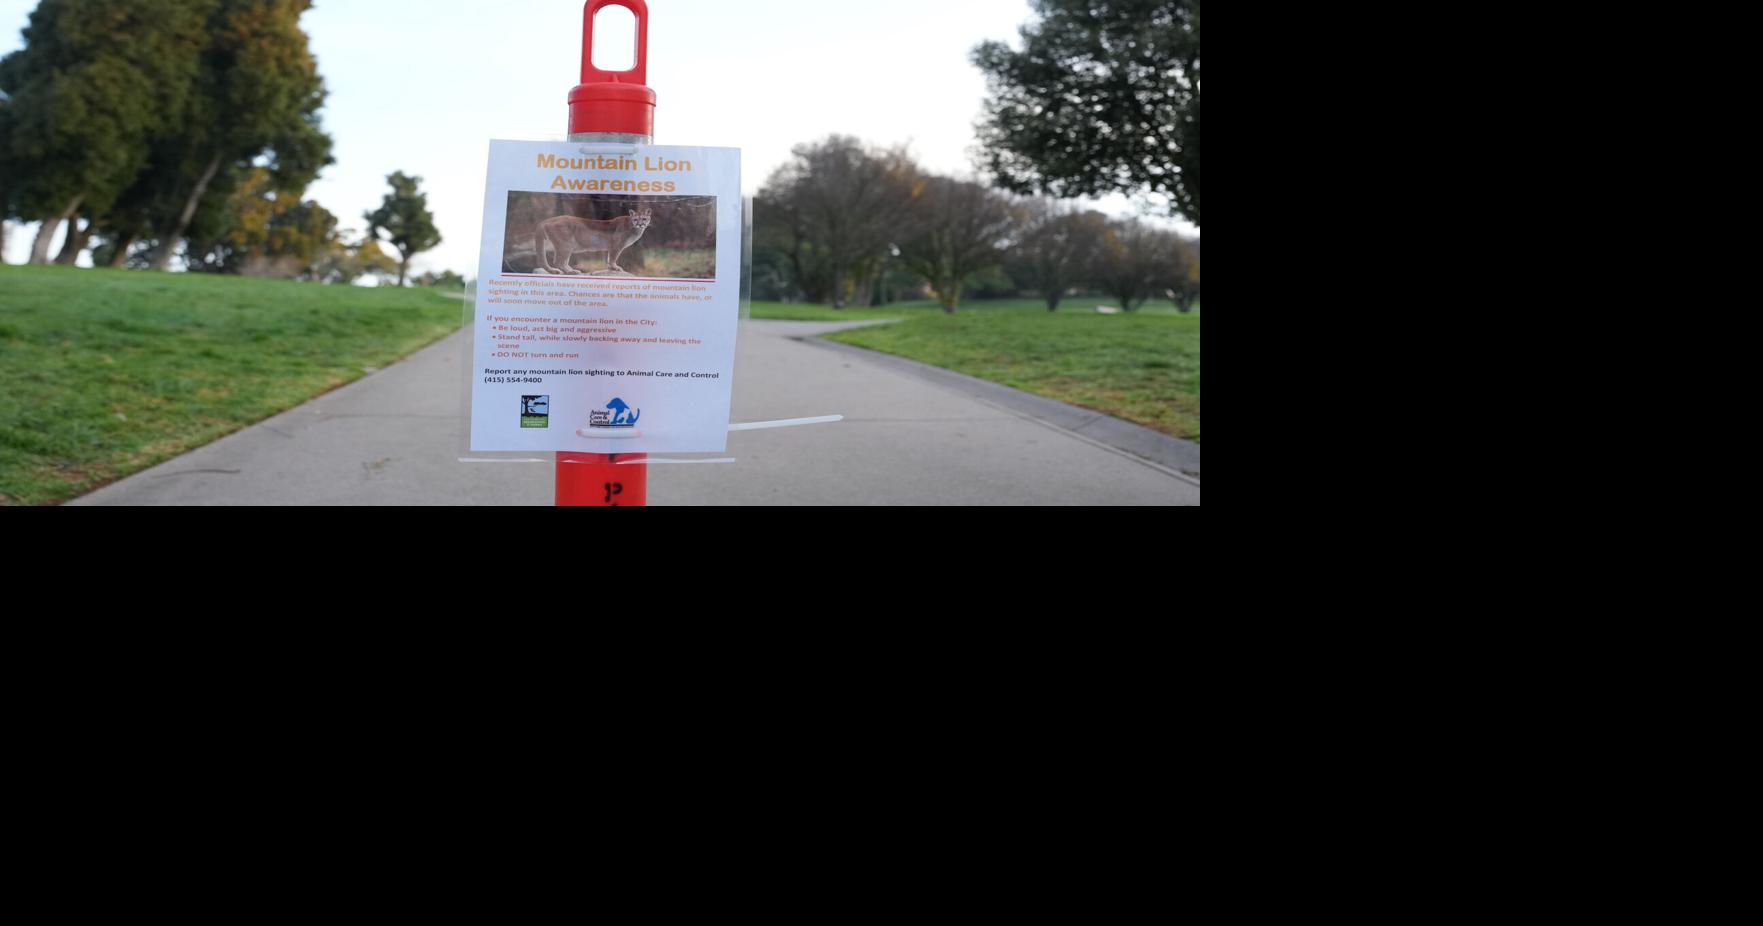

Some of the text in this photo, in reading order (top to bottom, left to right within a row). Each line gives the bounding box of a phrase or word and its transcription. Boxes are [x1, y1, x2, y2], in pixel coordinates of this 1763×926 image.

[537, 153, 692, 171] Mountain Lion
[551, 175, 676, 192] Awareness
[489, 279, 522, 287] Recently
[524, 280, 555, 288] officials
[577, 282, 609, 290] received
[588, 335, 619, 343] backing
[659, 337, 687, 345] leaving
[584, 369, 615, 377] sighting
